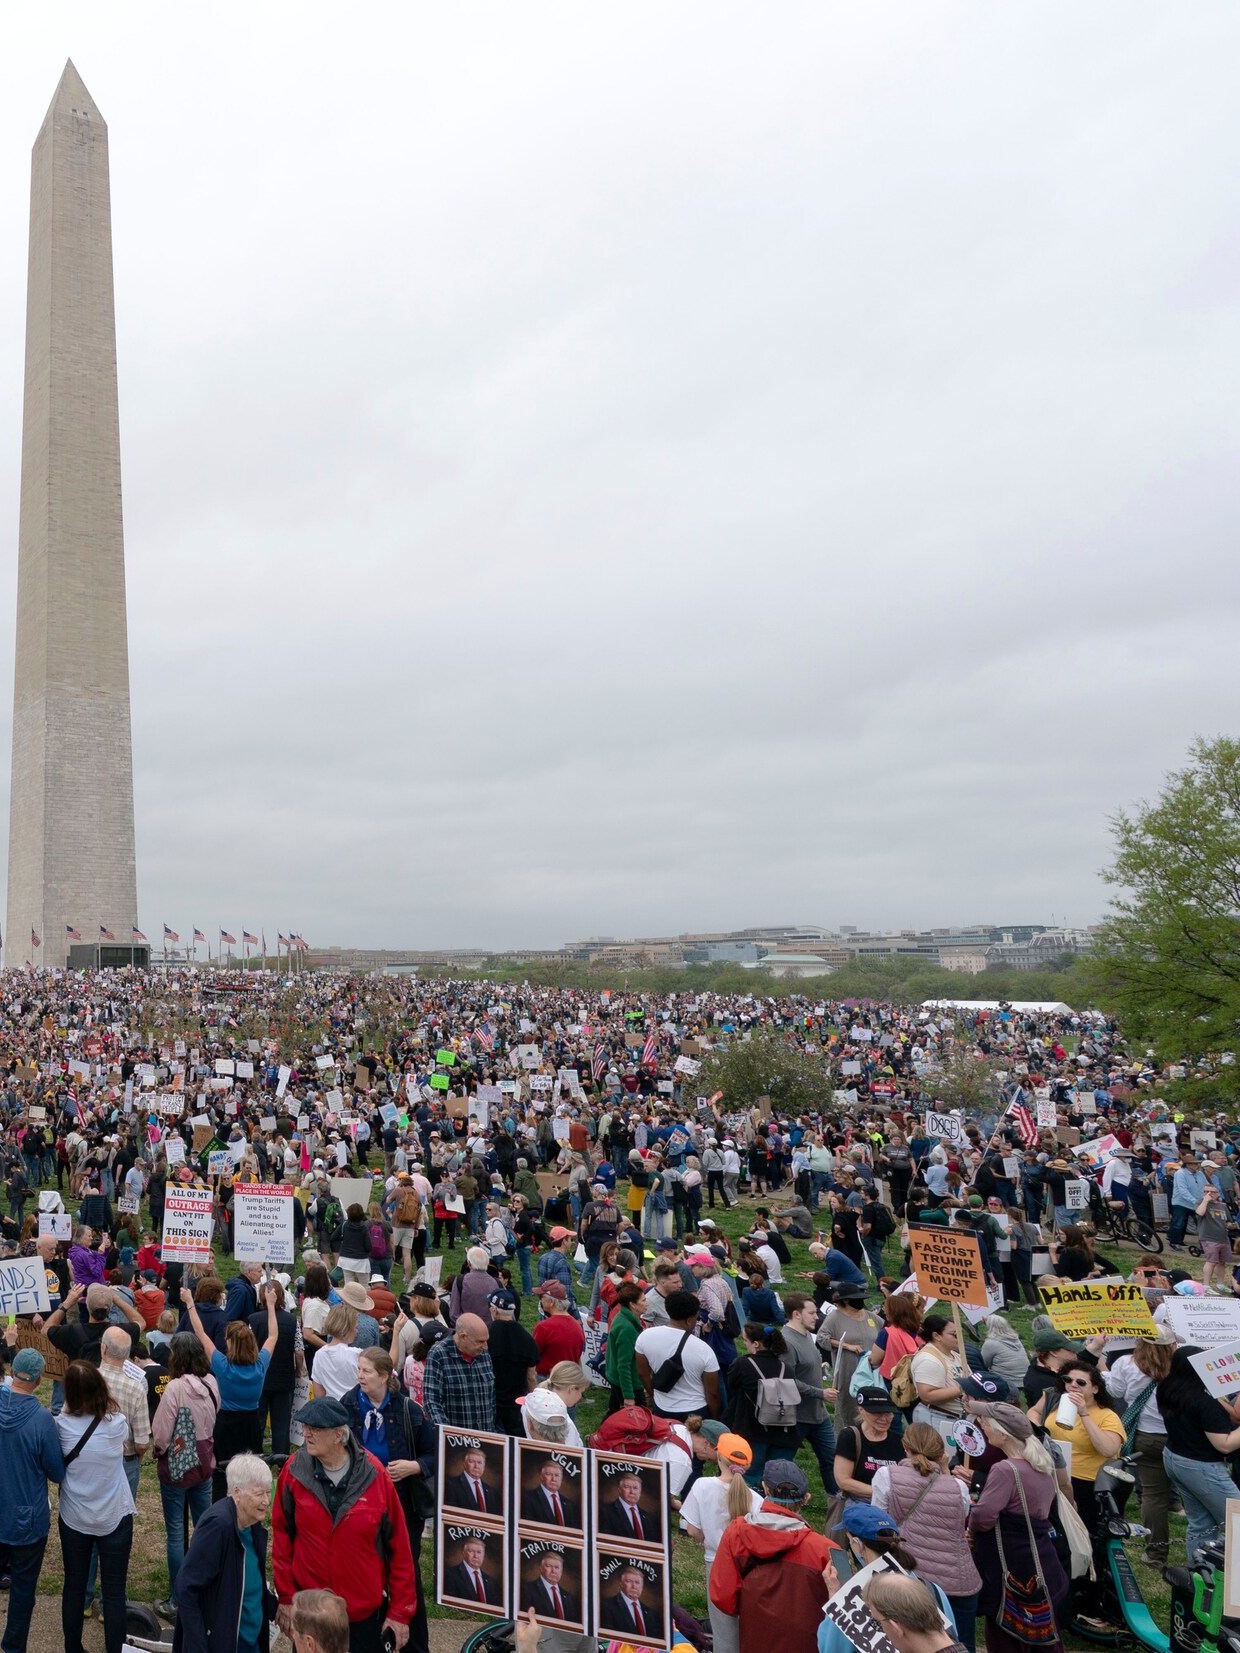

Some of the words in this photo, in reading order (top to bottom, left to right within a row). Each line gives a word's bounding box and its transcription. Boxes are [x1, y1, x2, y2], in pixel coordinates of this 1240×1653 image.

[931, 1116, 957, 1138] DOGE
[171, 1189, 186, 1197] ALL
[168, 1200, 210, 1211] OUTRAGE
[1071, 1198, 1080, 1206] DC
[173, 1211, 193, 1219] CAN'T
[240, 1221, 274, 1229] Alienating
[166, 1228, 187, 1236] THIS
[188, 1229, 209, 1238] SIGN
[930, 1234, 957, 1245] The
[914, 1242, 976, 1258] FASCIST
[920, 1253, 973, 1267] TRUMP
[920, 1263, 978, 1279] REGIME
[929, 1275, 971, 1288] MUST
[939, 1287, 965, 1298] GO!
[1040, 1285, 1102, 1305] Hands
[1107, 1285, 1143, 1301] Off!
[1206, 1352, 1240, 1371] CLOWN
[1217, 1370, 1240, 1384] ENE
[447, 1435, 481, 1449] DUMB
[551, 1450, 581, 1478] UGLY
[602, 1462, 643, 1478] RACIST
[865, 1462, 876, 1470] SHE
[448, 1526, 490, 1541] RAPIST
[520, 1540, 565, 1560] TRAITOR
[600, 1558, 622, 1580] SMALL
[629, 1558, 658, 1582] HANDS
